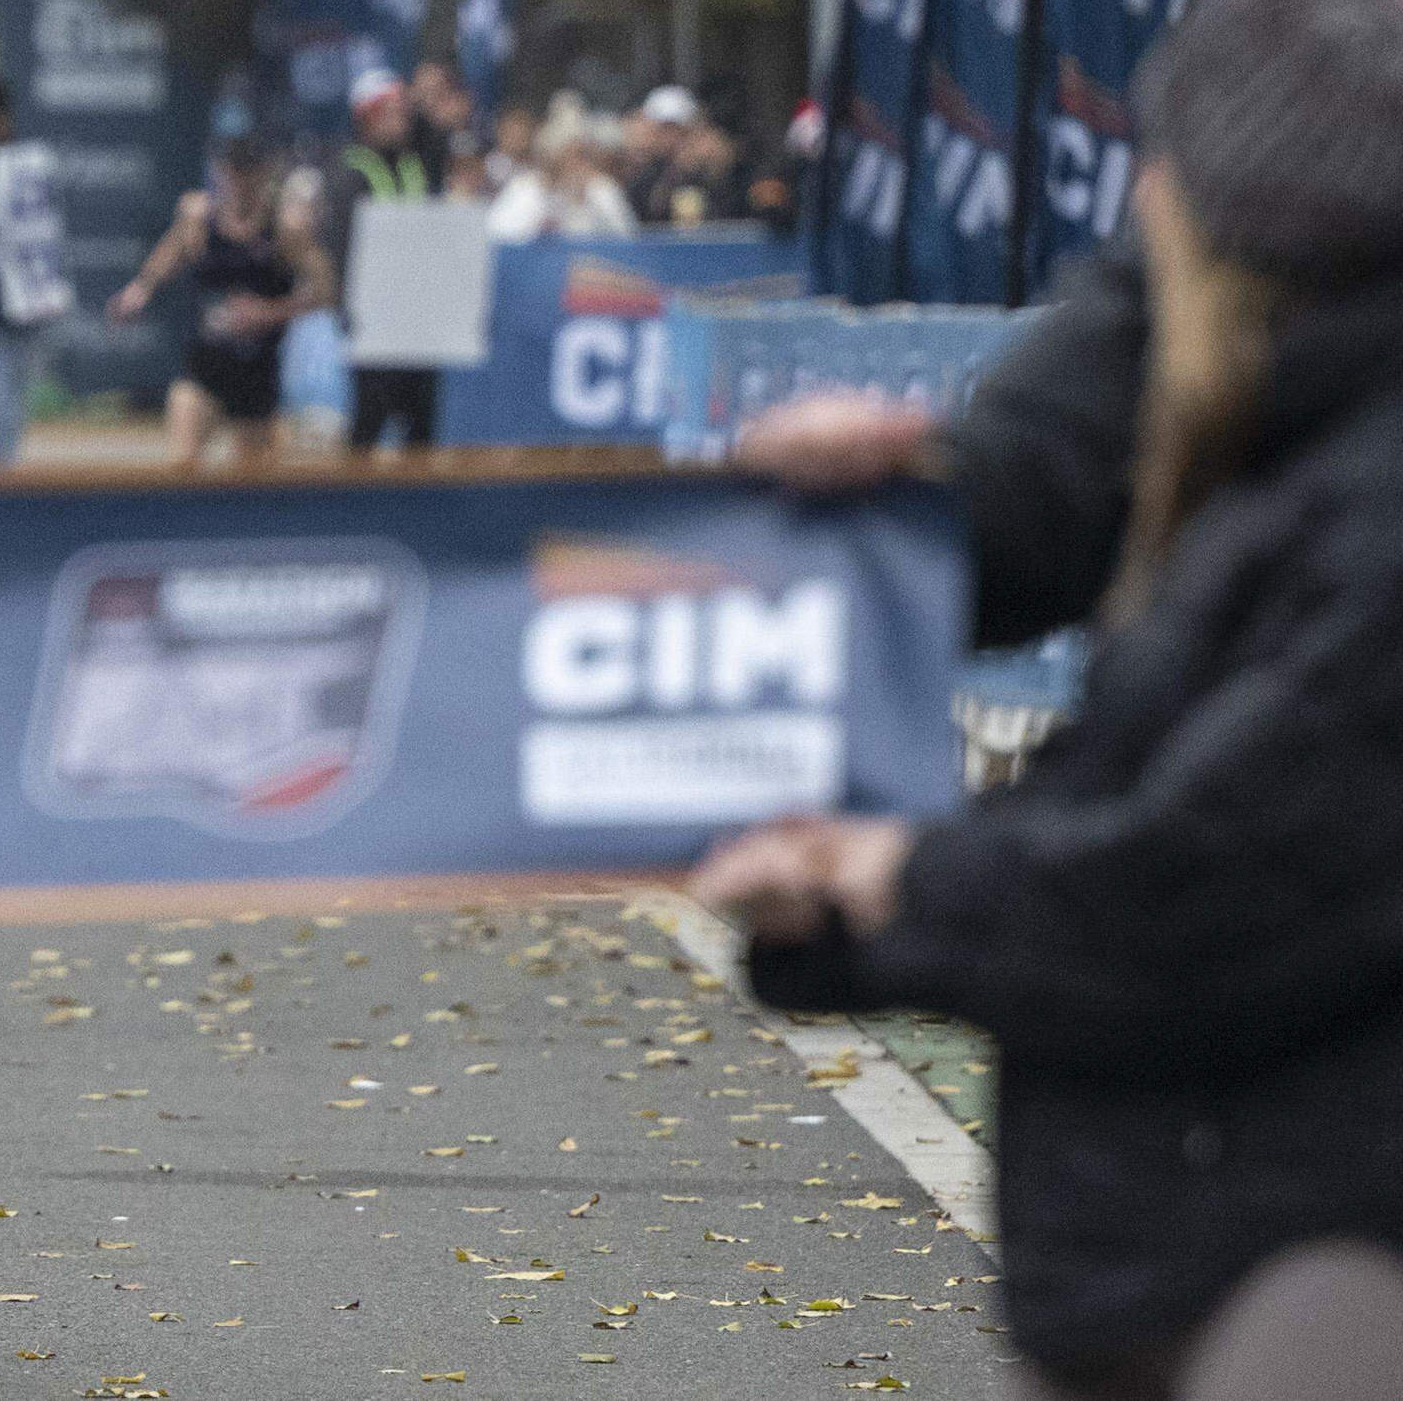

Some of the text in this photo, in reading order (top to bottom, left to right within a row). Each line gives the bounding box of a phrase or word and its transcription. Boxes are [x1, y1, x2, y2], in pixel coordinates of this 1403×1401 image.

[1045, 116, 1133, 237] CI
[549, 313, 670, 428] CI
[523, 577, 843, 713] CIM
